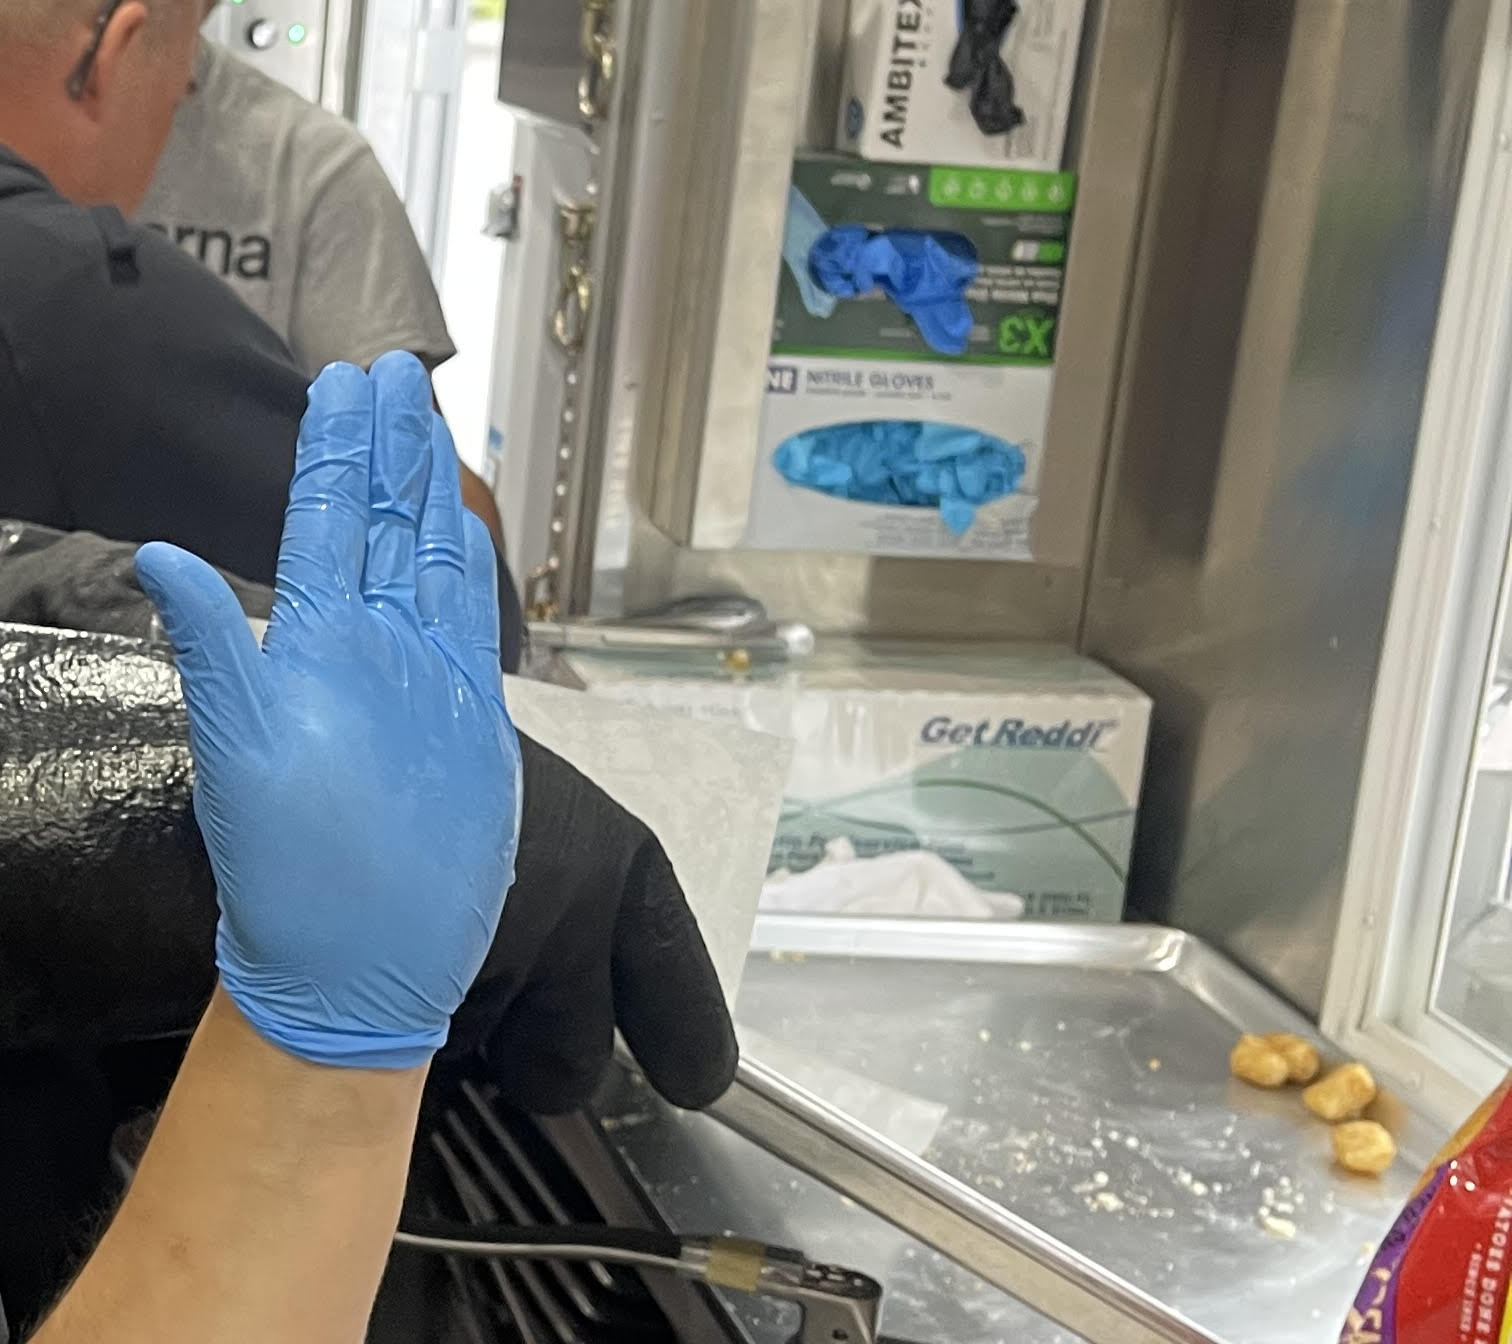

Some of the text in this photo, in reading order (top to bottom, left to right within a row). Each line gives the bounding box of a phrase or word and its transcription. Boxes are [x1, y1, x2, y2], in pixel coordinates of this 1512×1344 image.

[806, 369, 863, 387] NITRILE
[869, 371, 935, 391] GLOVES
[920, 716, 1102, 750] Get Reddi
[1476, 1277, 1497, 1333] DONE
